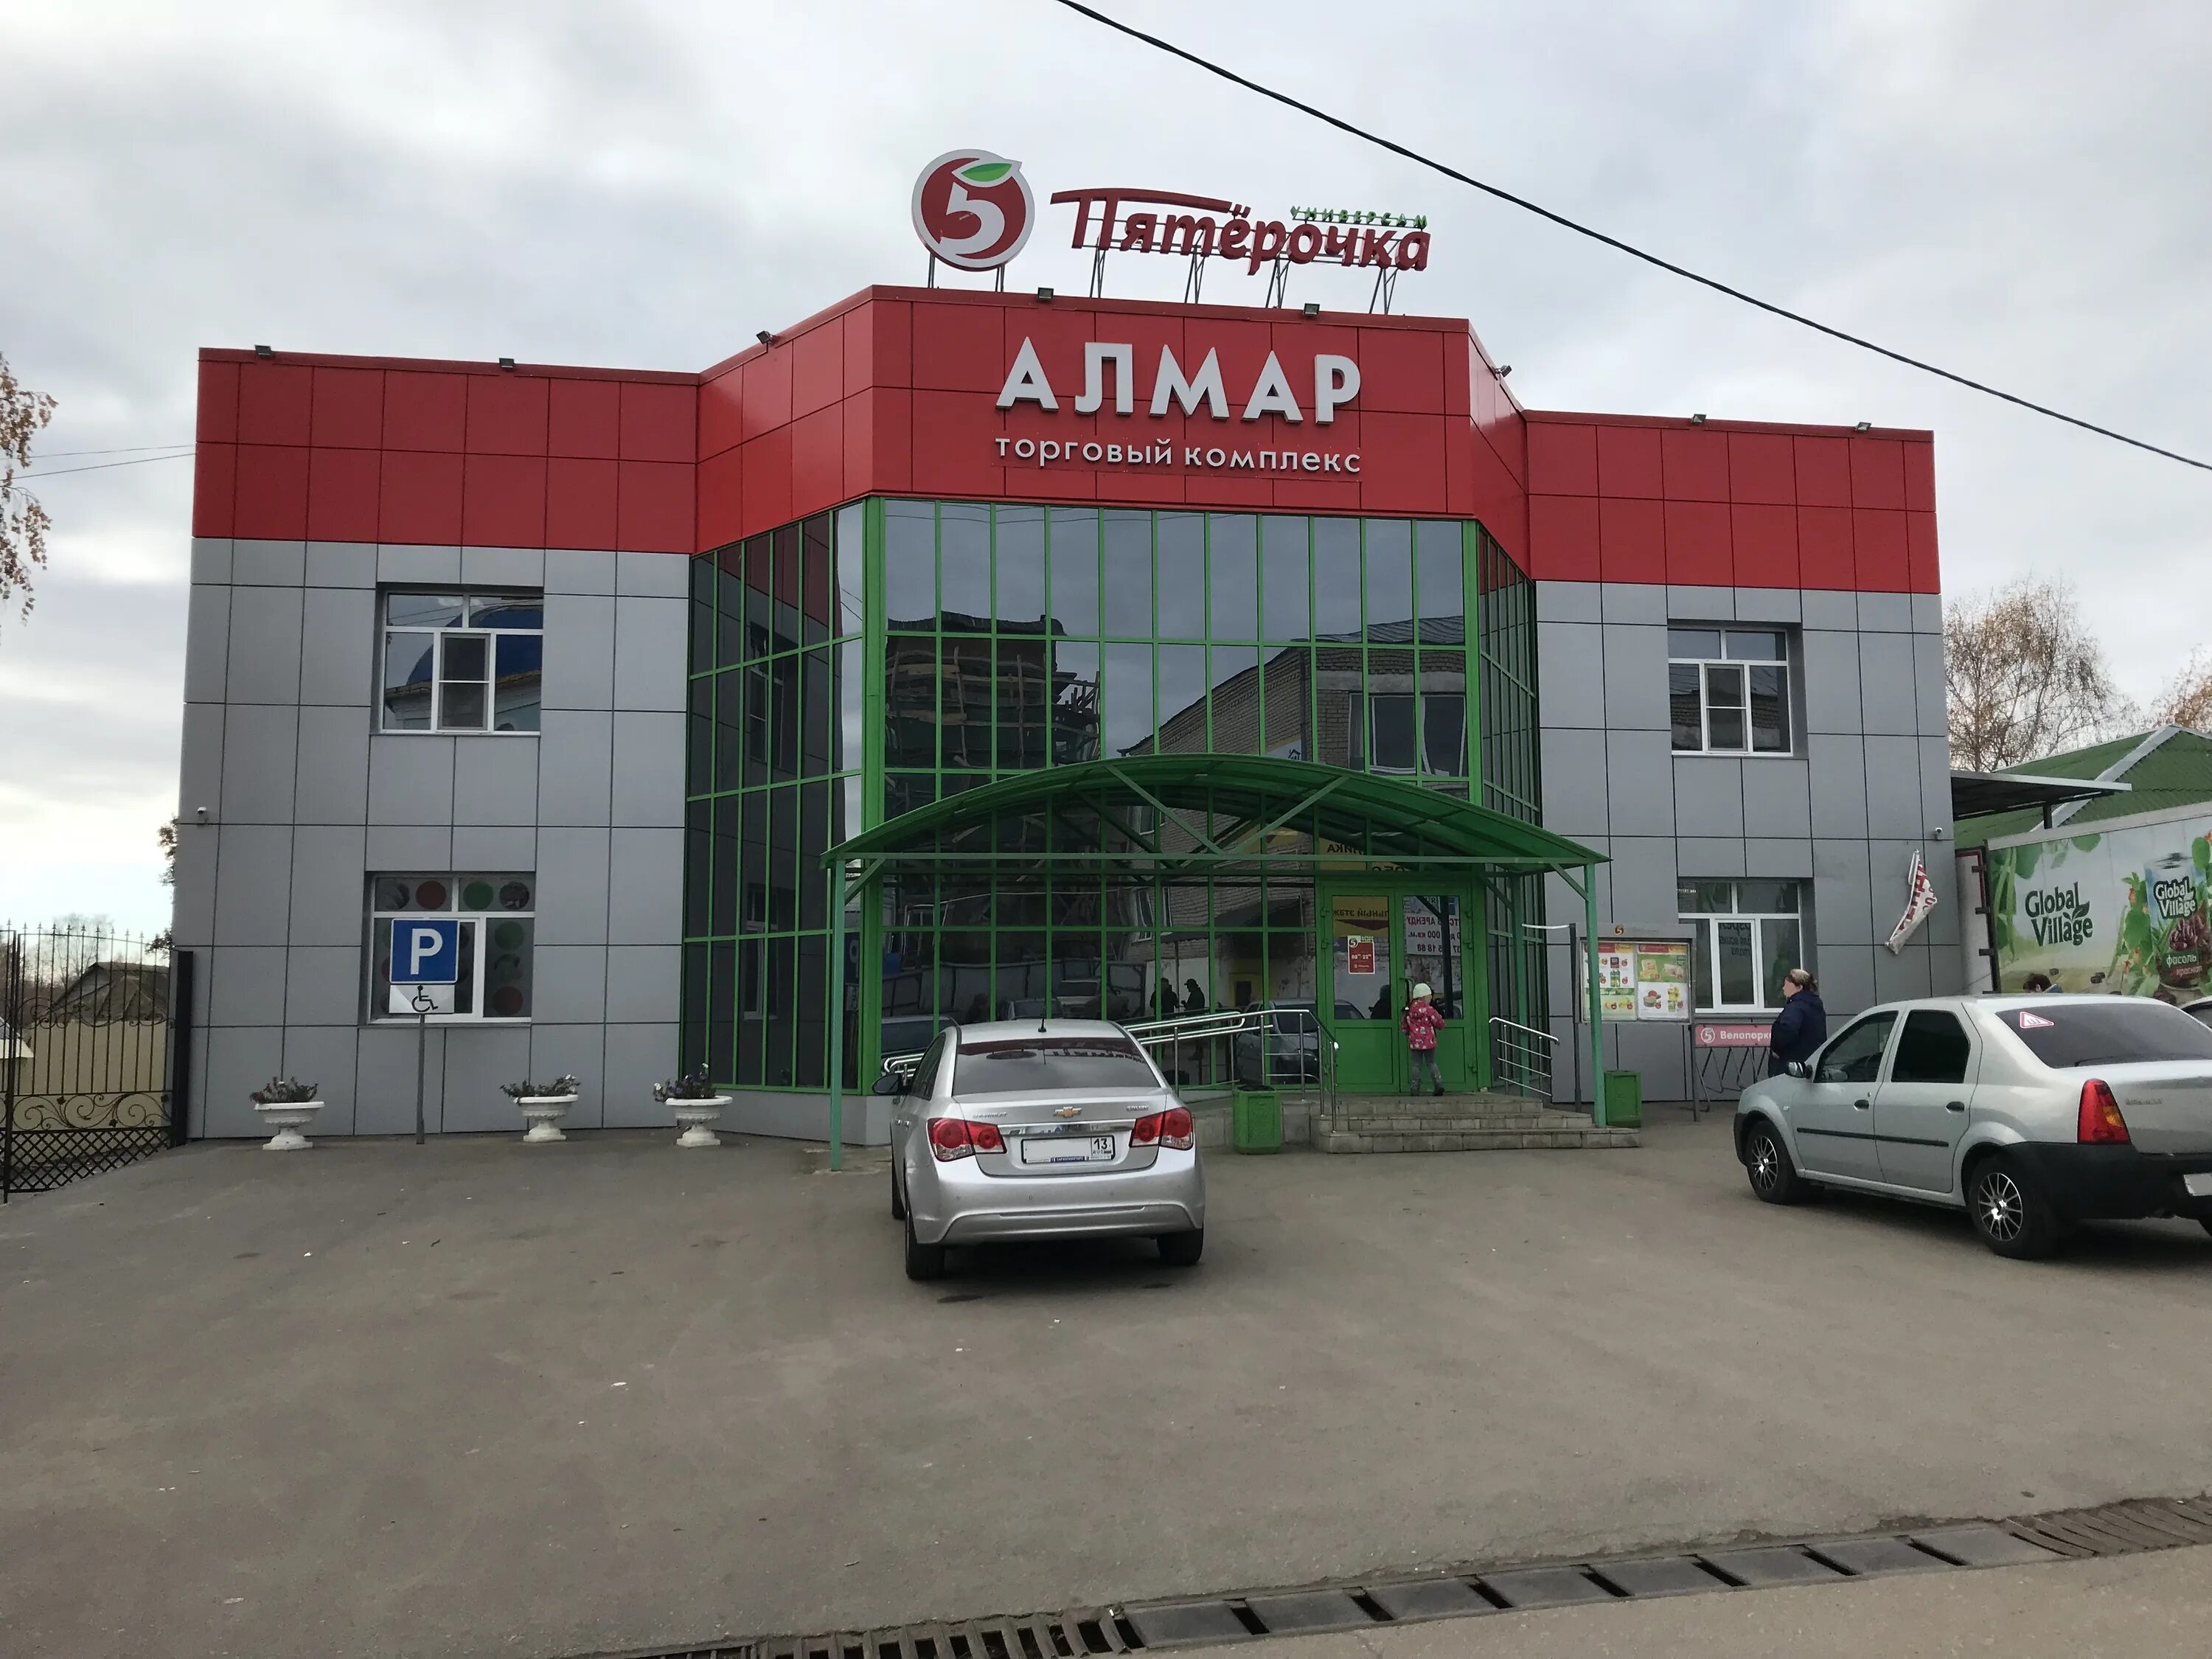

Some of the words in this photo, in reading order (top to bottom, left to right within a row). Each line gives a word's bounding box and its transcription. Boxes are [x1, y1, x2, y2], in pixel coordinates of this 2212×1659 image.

[1051, 188, 1433, 276] Пятёрочка
[1290, 206, 1427, 232] УНИВЕРСАМ
[995, 336, 1361, 425] АЛМАР
[995, 436, 1172, 467] торговый
[1185, 447, 1361, 474] комплекс
[2160, 897, 2197, 917] Village
[2031, 911, 2093, 947] Village
[410, 928, 443, 975] P
[1093, 1138, 1108, 1150] 13
